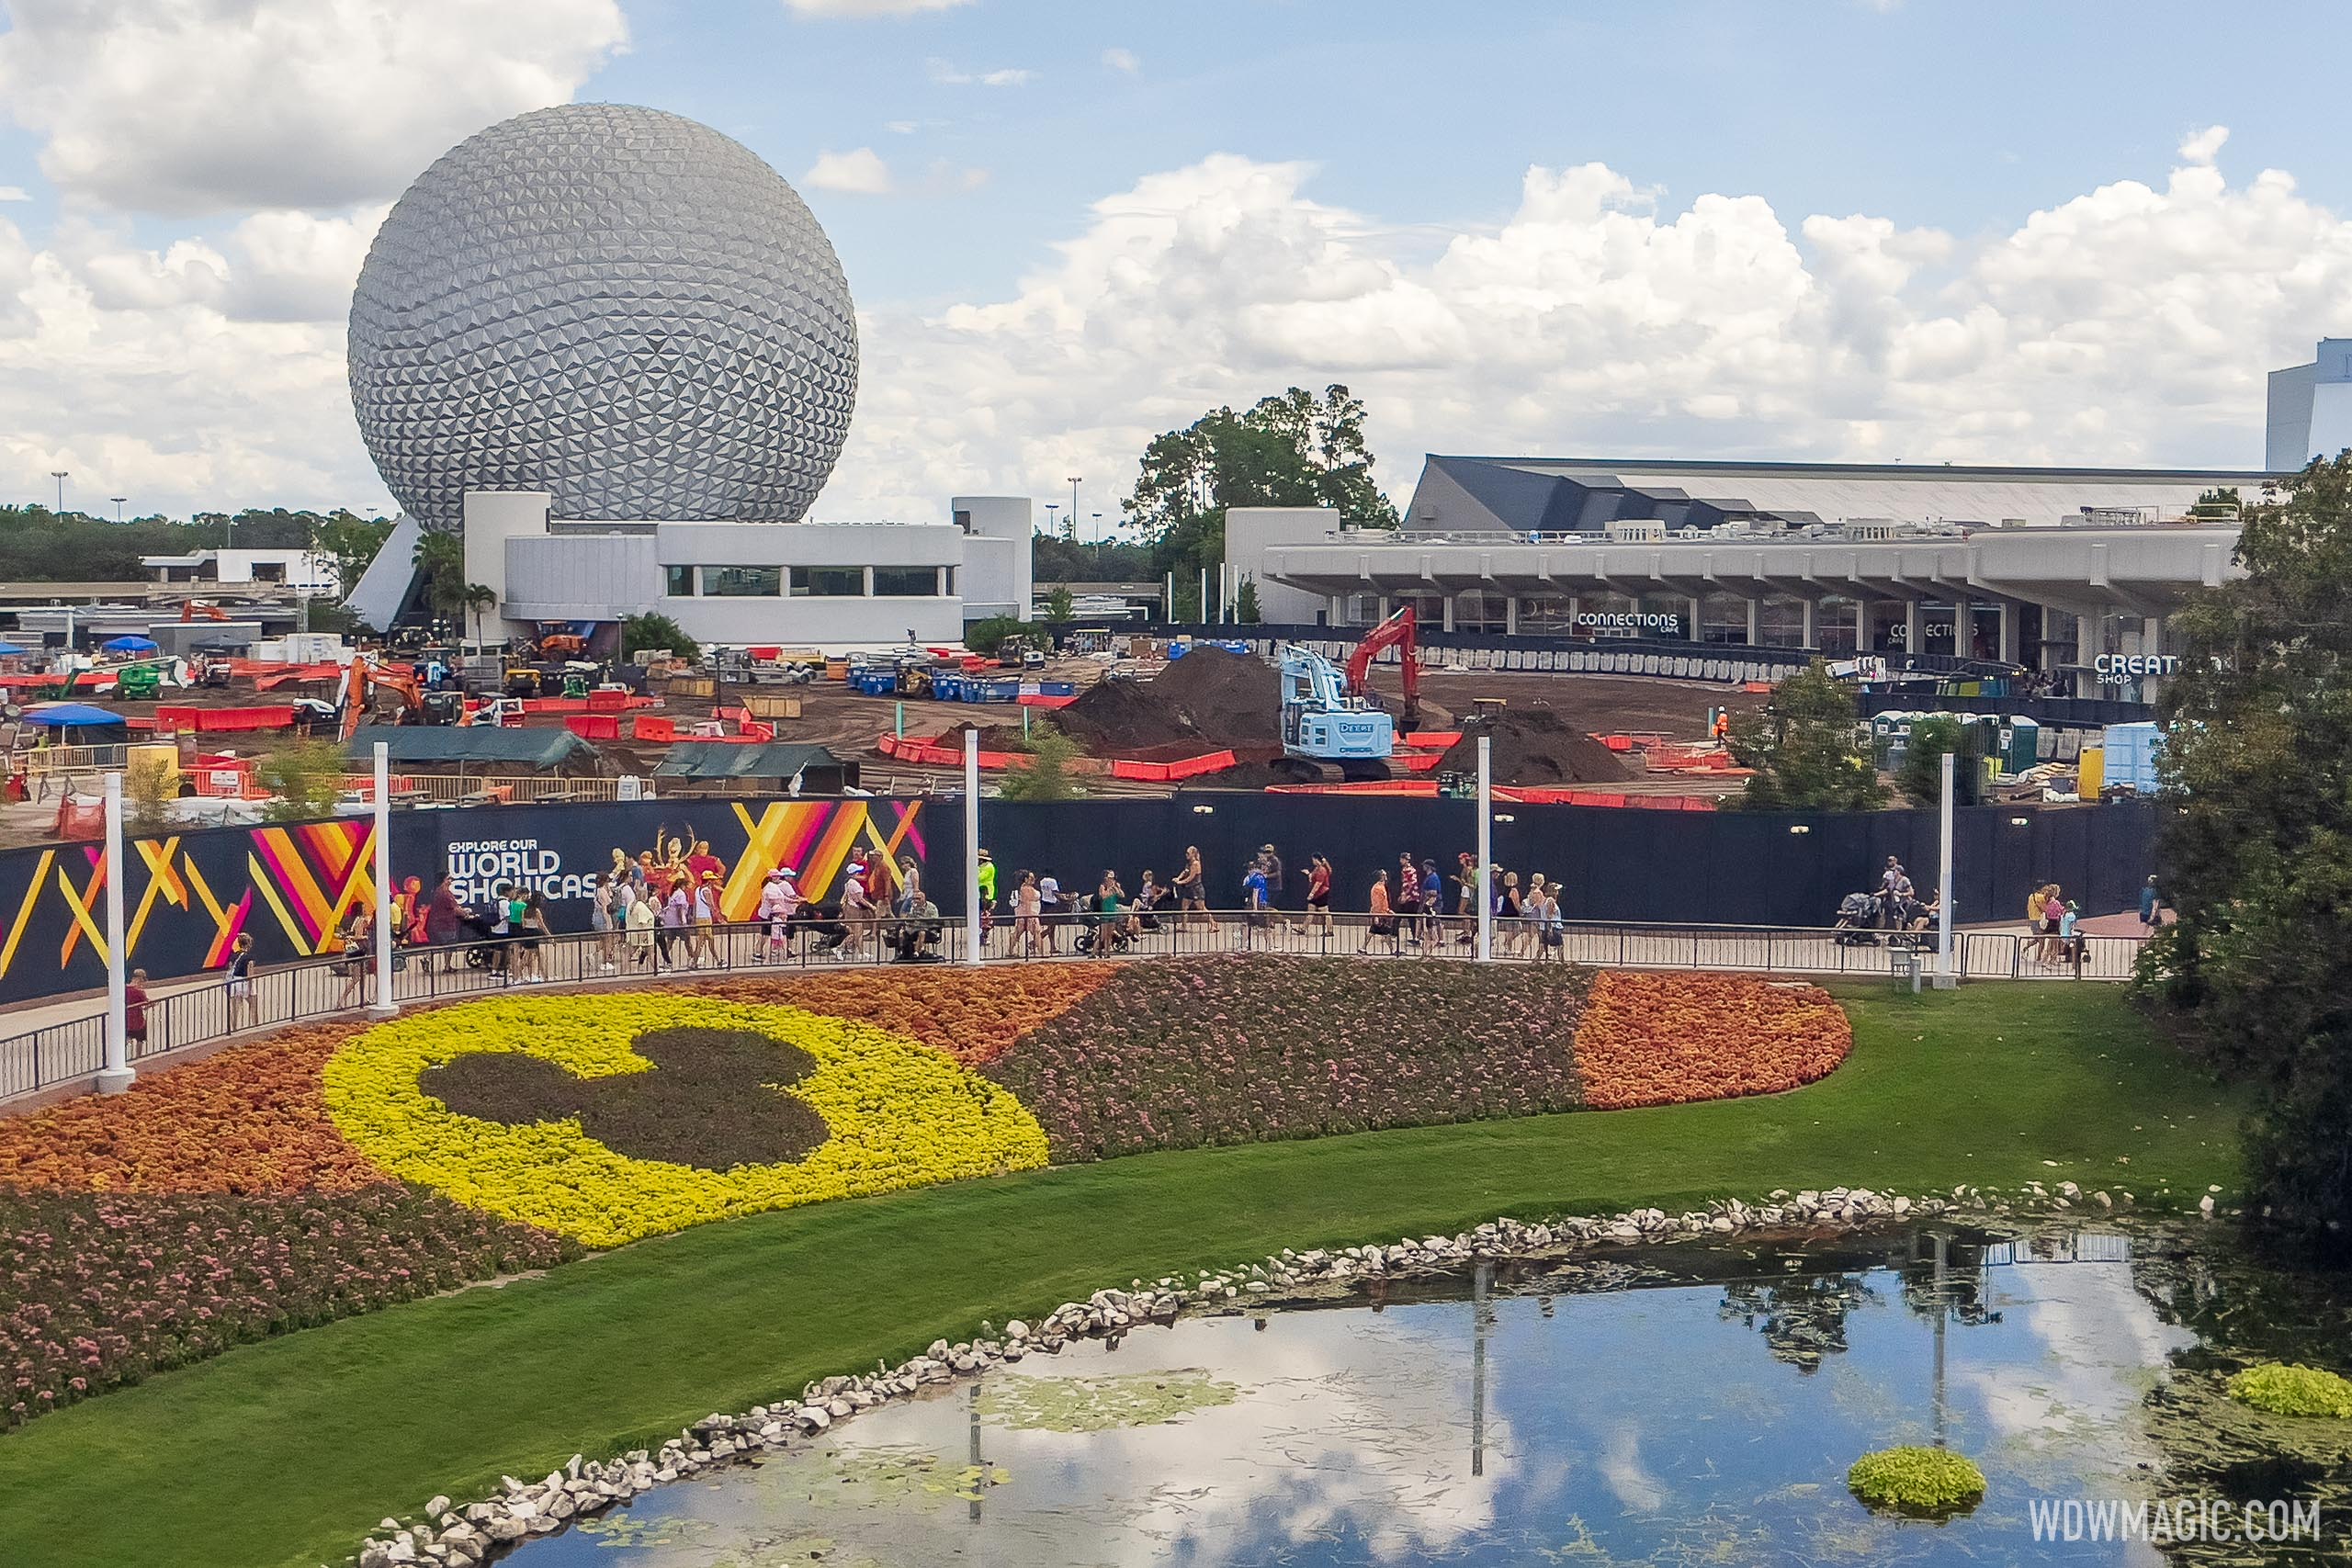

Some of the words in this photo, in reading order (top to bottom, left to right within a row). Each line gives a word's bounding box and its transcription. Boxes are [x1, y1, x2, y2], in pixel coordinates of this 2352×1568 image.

[1577, 613, 1678, 626] CONNECTIONS
[1890, 623, 1979, 637] COECTIS
[2097, 674, 2132, 685] SHOP
[448, 840, 507, 853] EXPLORE
[510, 839, 537, 851] OUR
[448, 850, 560, 879] WORLD
[448, 873, 598, 905] SHOWCAS
